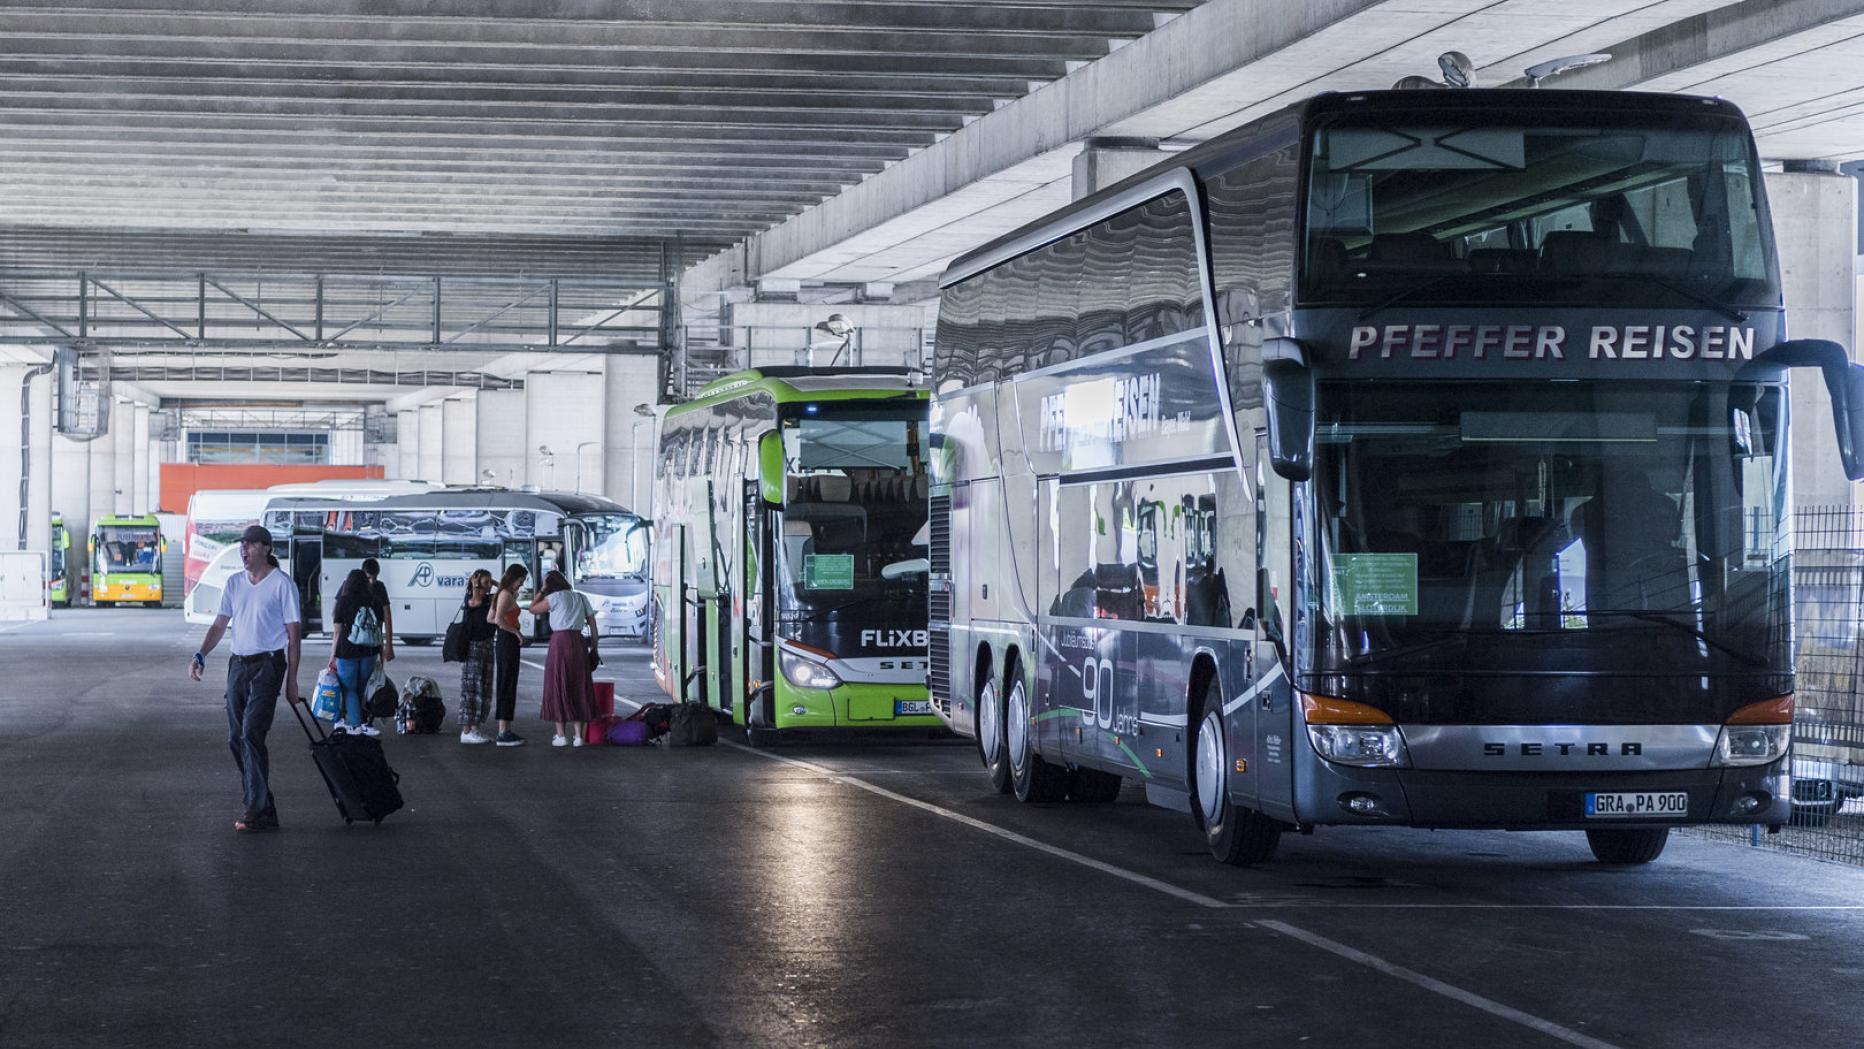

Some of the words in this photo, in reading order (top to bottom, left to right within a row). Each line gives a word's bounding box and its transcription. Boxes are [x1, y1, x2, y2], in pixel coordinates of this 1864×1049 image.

[1349, 325, 1567, 360] PFEFFER
[1589, 325, 1754, 360] REISEN
[1107, 373, 1160, 442] EISEN
[902, 702, 919, 712] BGL
[1082, 656, 1113, 729] 90
[1113, 705, 1138, 737] Jahre
[1483, 742, 1643, 756] SETRA
[1596, 794, 1624, 812] GRA
[1635, 794, 1654, 812] PA
[1658, 794, 1686, 811] 900
